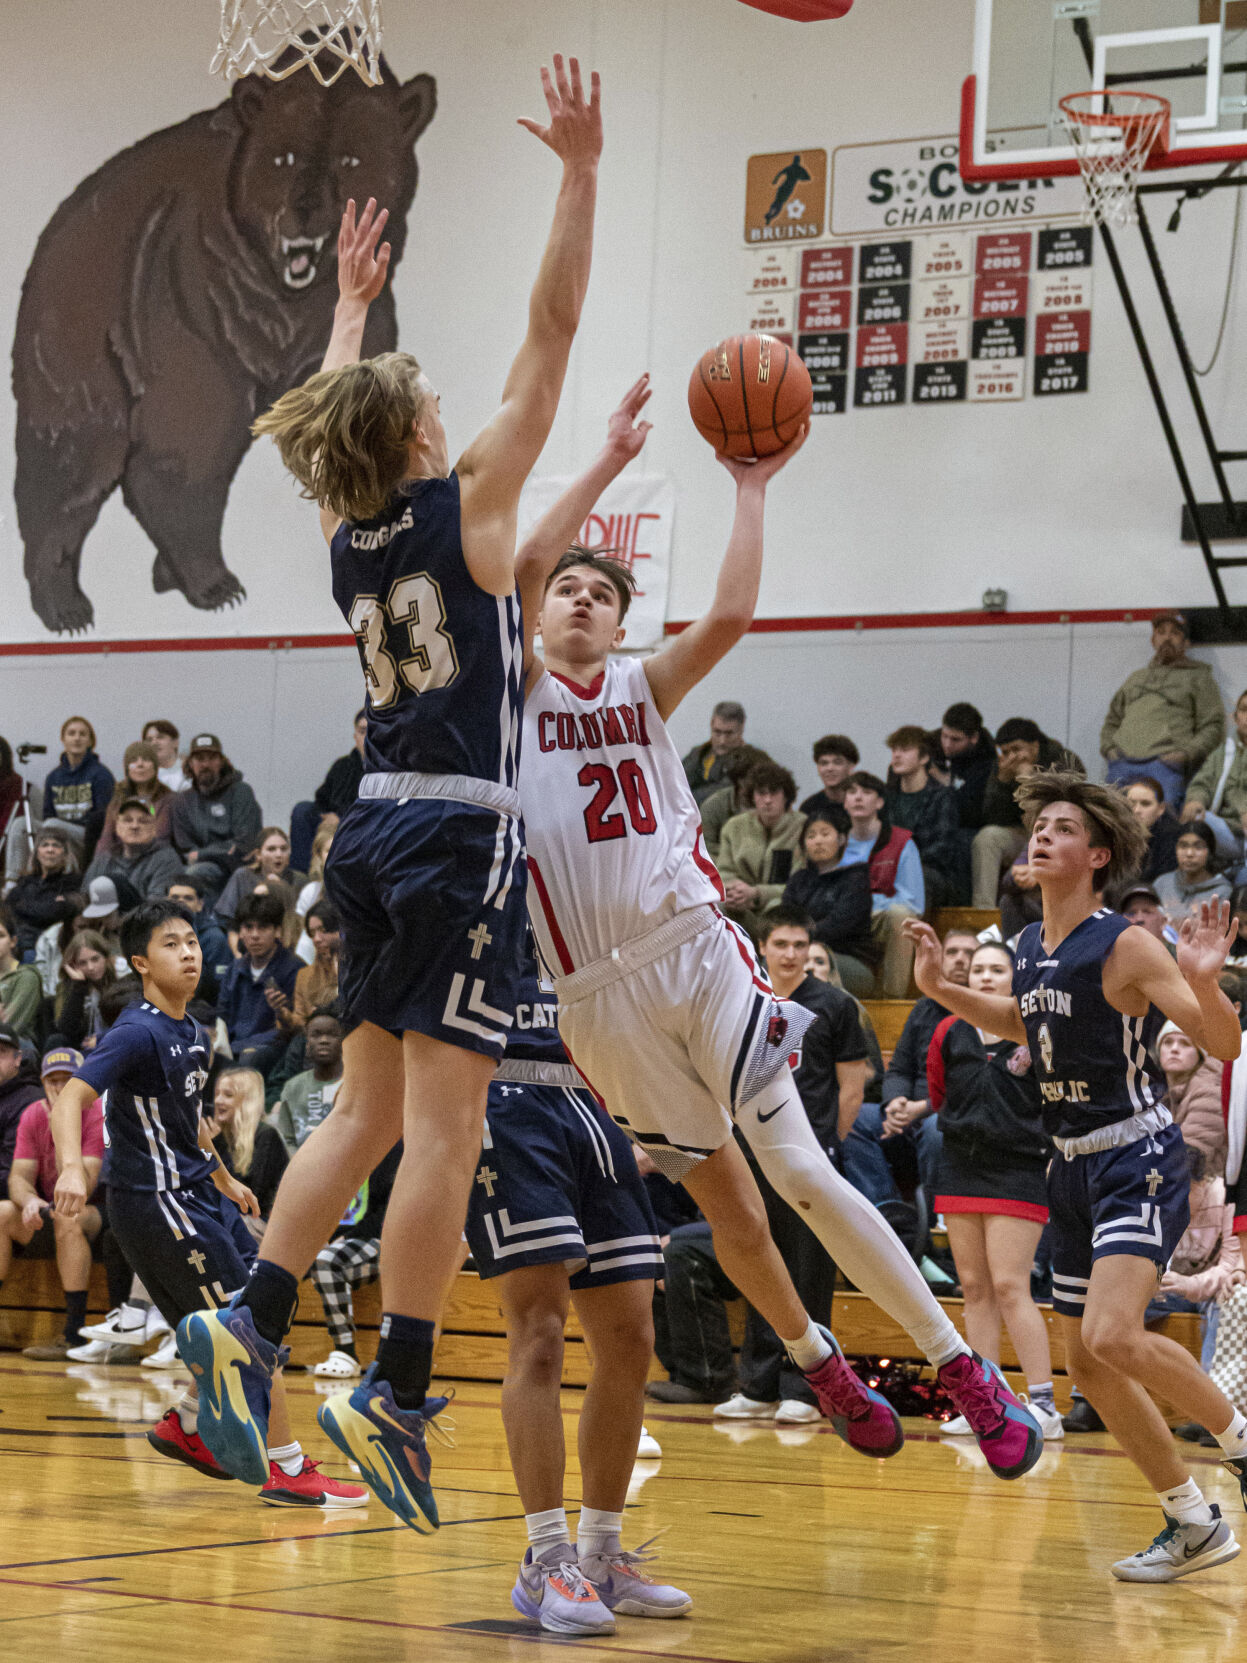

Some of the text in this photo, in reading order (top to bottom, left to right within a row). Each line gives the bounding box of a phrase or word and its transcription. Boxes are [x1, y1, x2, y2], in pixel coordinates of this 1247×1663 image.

[884, 195, 1036, 226] CHAMPIONS
[751, 224, 818, 241] BRUINS
[983, 256, 1021, 270] 2005
[1045, 249, 1084, 265] 2005
[925, 260, 962, 273] 2005
[924, 304, 960, 318] 2007
[981, 299, 1018, 313] 2007
[977, 383, 1013, 394] 2016
[1041, 376, 1078, 391] 2017
[920, 384, 957, 399] 2015
[348, 571, 461, 711] 33
[577, 758, 658, 844] 20
[1021, 983, 1072, 1018] SETON
[516, 1003, 557, 1030] CAT
